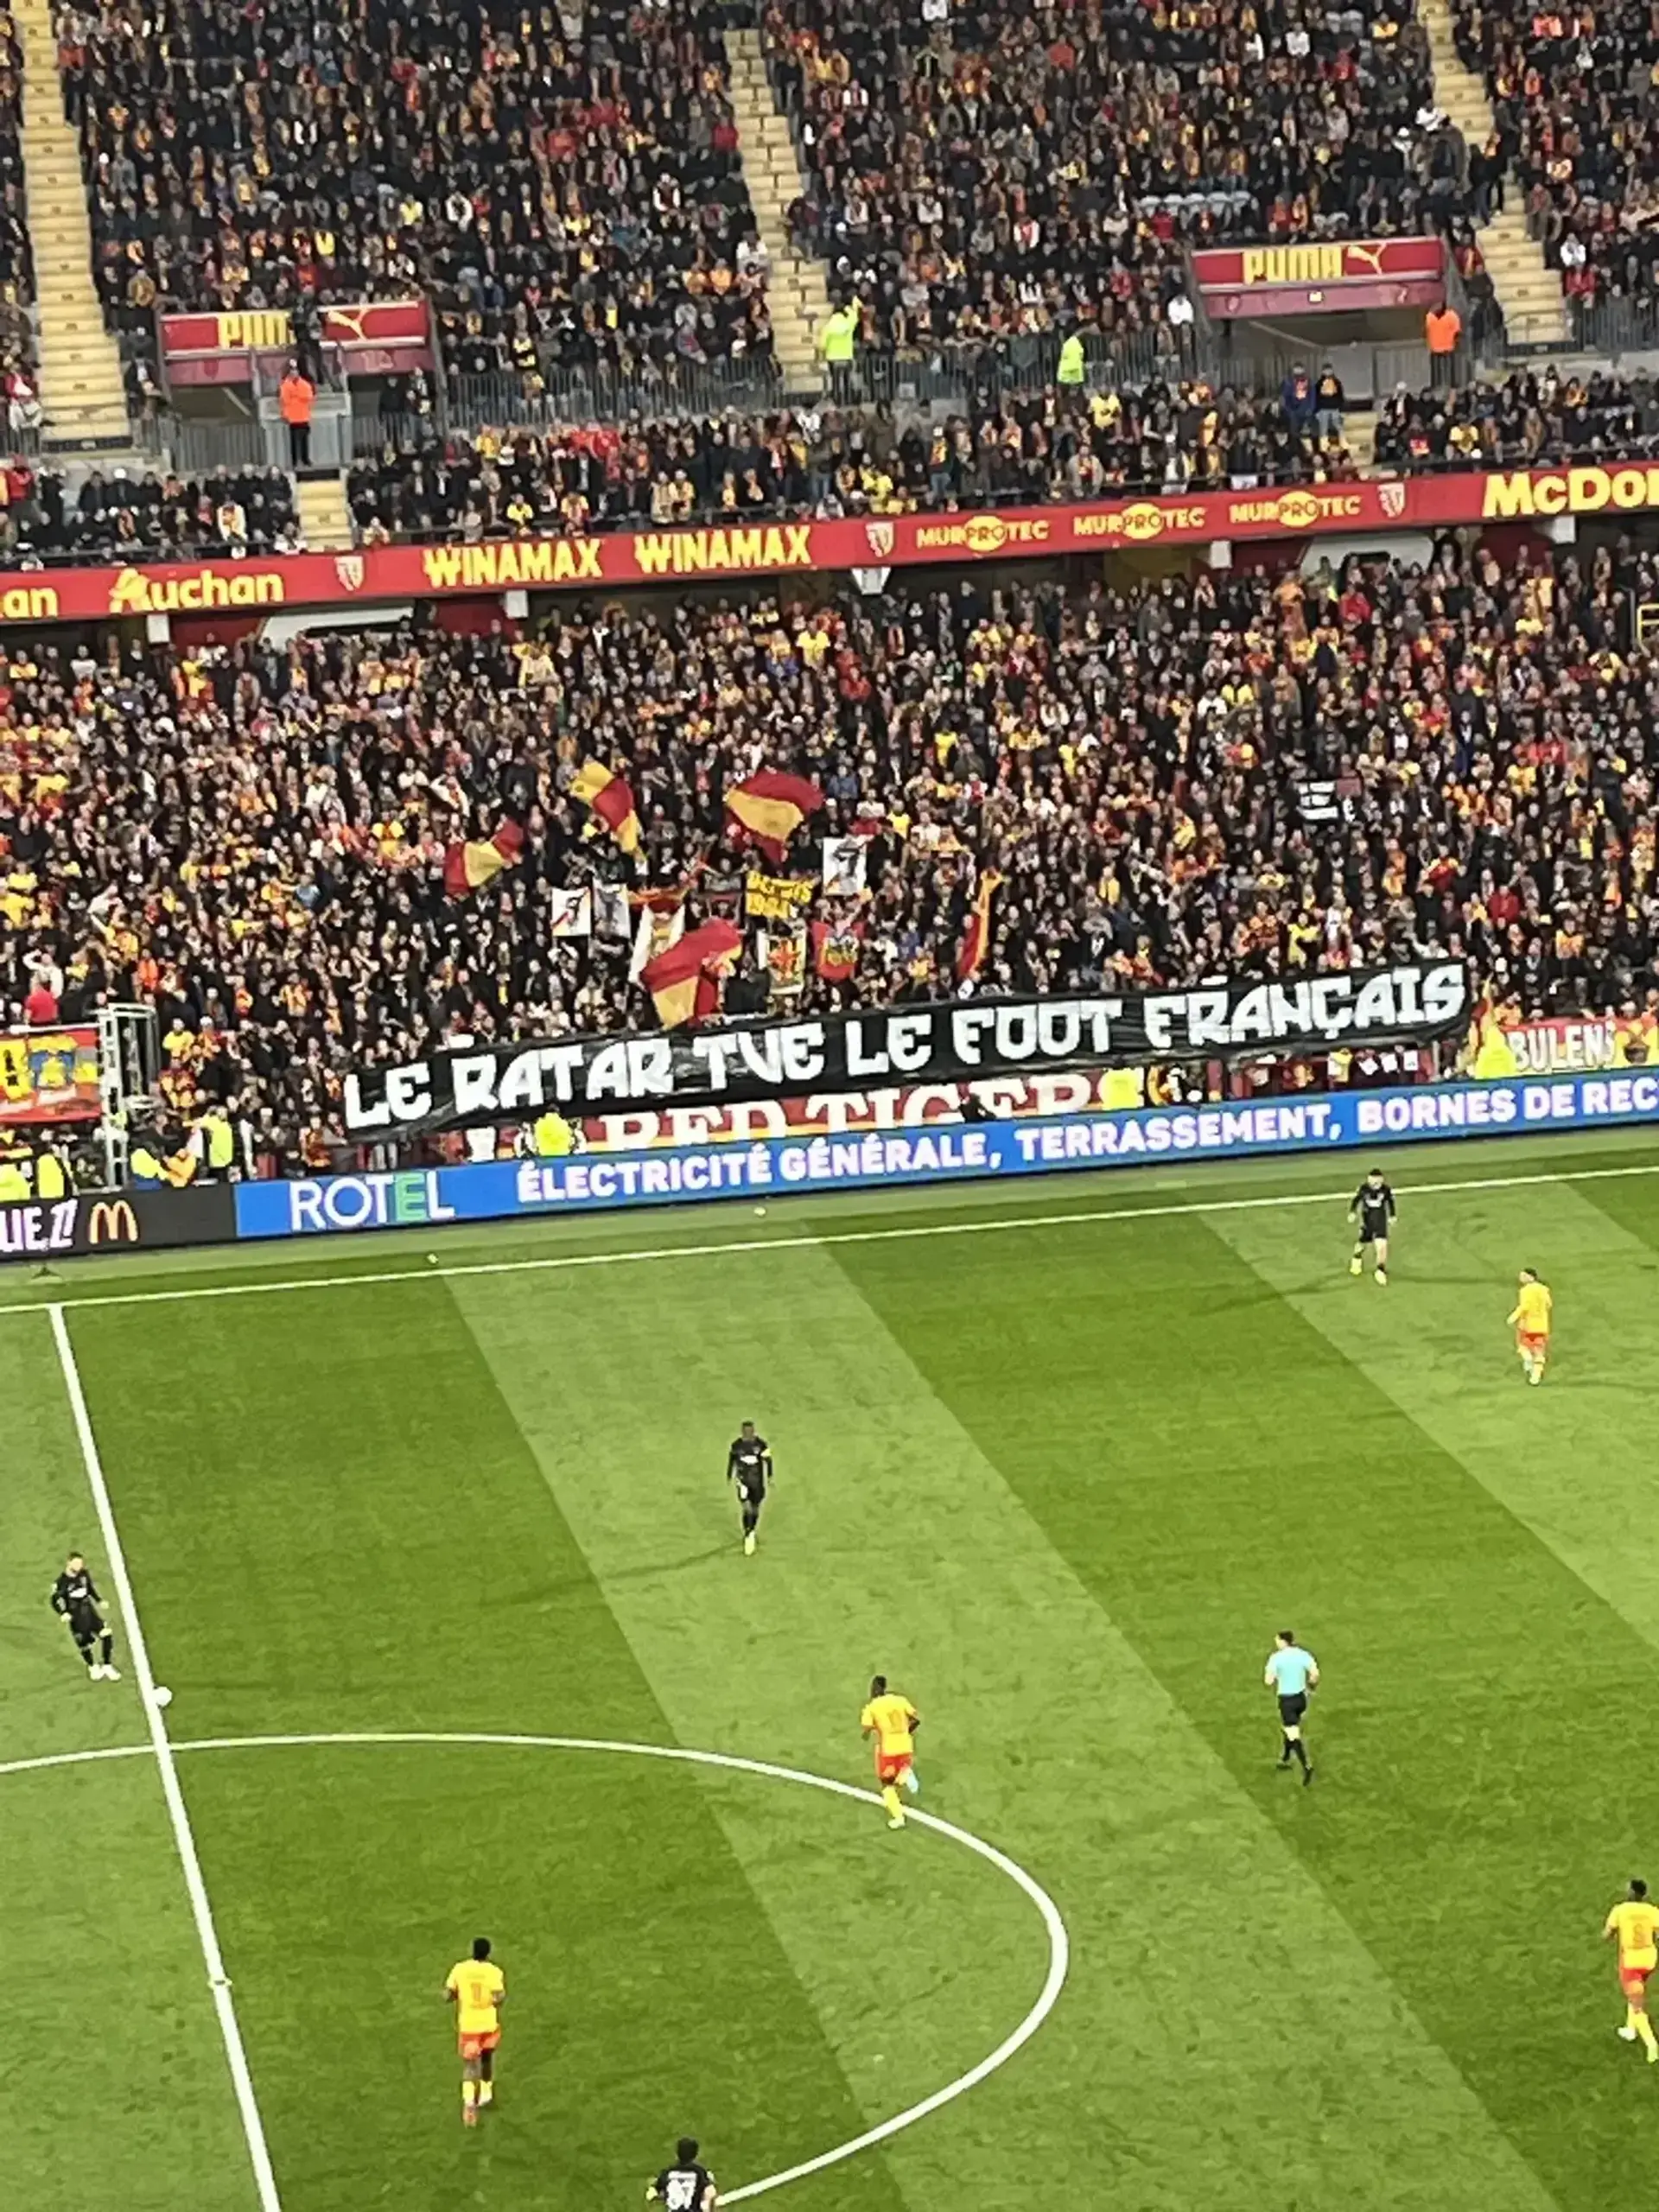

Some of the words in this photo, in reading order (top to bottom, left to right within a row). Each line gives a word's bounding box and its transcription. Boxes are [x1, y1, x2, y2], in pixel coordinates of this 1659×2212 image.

[1242, 245, 1343, 286] PUMA
[218, 309, 296, 349] PUM
[1074, 507, 1205, 537] MURPROTEC
[1230, 495, 1362, 524] MURPROTEC
[635, 525, 812, 574] WINAMAX
[916, 519, 1050, 549] MURPROTEC
[424, 538, 603, 588] WINAMAX
[0, 586, 58, 620] an
[110, 567, 284, 613] Auchan
[344, 1062, 432, 1129] LE
[845, 1014, 933, 1077] LE
[952, 998, 1123, 1065] FOOT
[1143, 963, 1465, 1049] FRANÇAIS
[805, 1068, 1144, 1133] TIGER
[518, 1142, 772, 1203] ÉLECTRICITÉ
[780, 1132, 1002, 1181] GÉNÉRALE,
[1014, 1103, 1344, 1161] TERRASSEMENT,
[1357, 1087, 1517, 1134] BORNES
[1523, 1084, 1576, 1121] DE
[1582, 1077, 1659, 1116] REC
[289, 1170, 456, 1231] ROTEL
